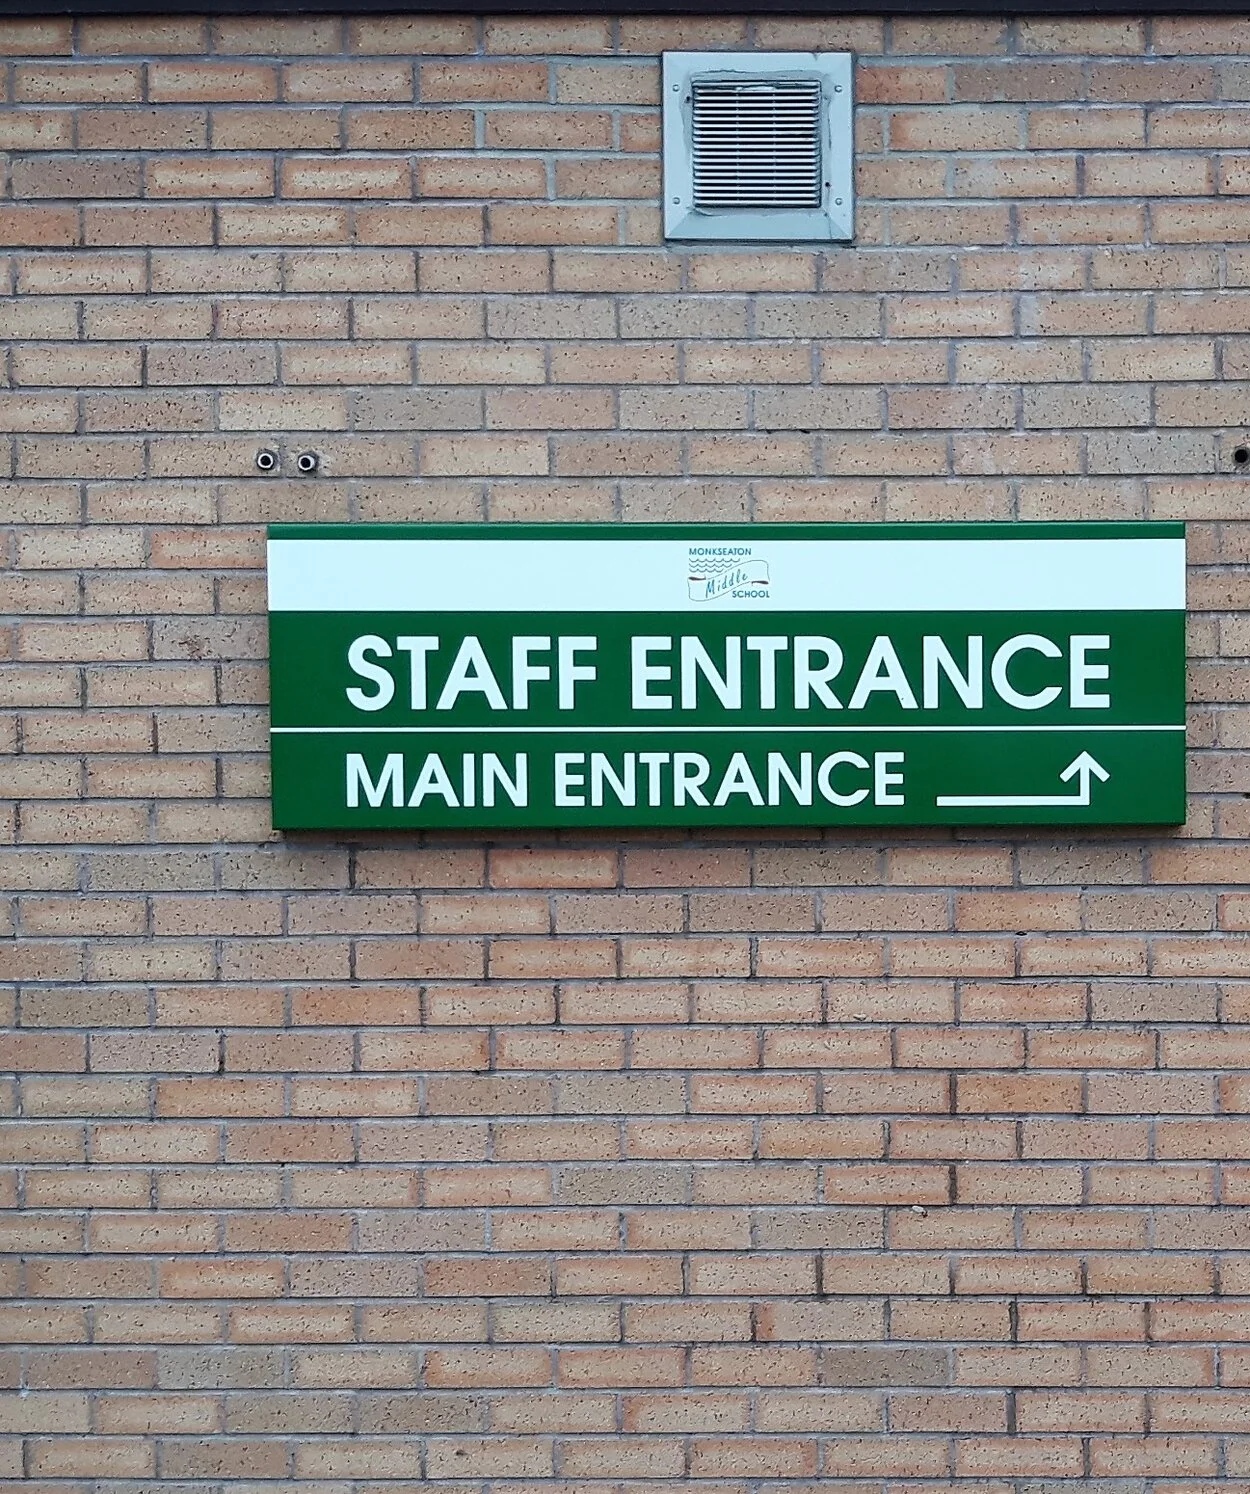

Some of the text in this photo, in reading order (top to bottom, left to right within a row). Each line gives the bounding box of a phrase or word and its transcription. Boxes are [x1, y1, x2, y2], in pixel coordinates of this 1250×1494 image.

[688, 547, 752, 556] MONKSEATON
[705, 568, 749, 599] Middle
[732, 590, 770, 598] SCHOOL
[346, 633, 1110, 711] STAFF ENTRANCE
[346, 751, 905, 808] MAIN ENTRANCE
